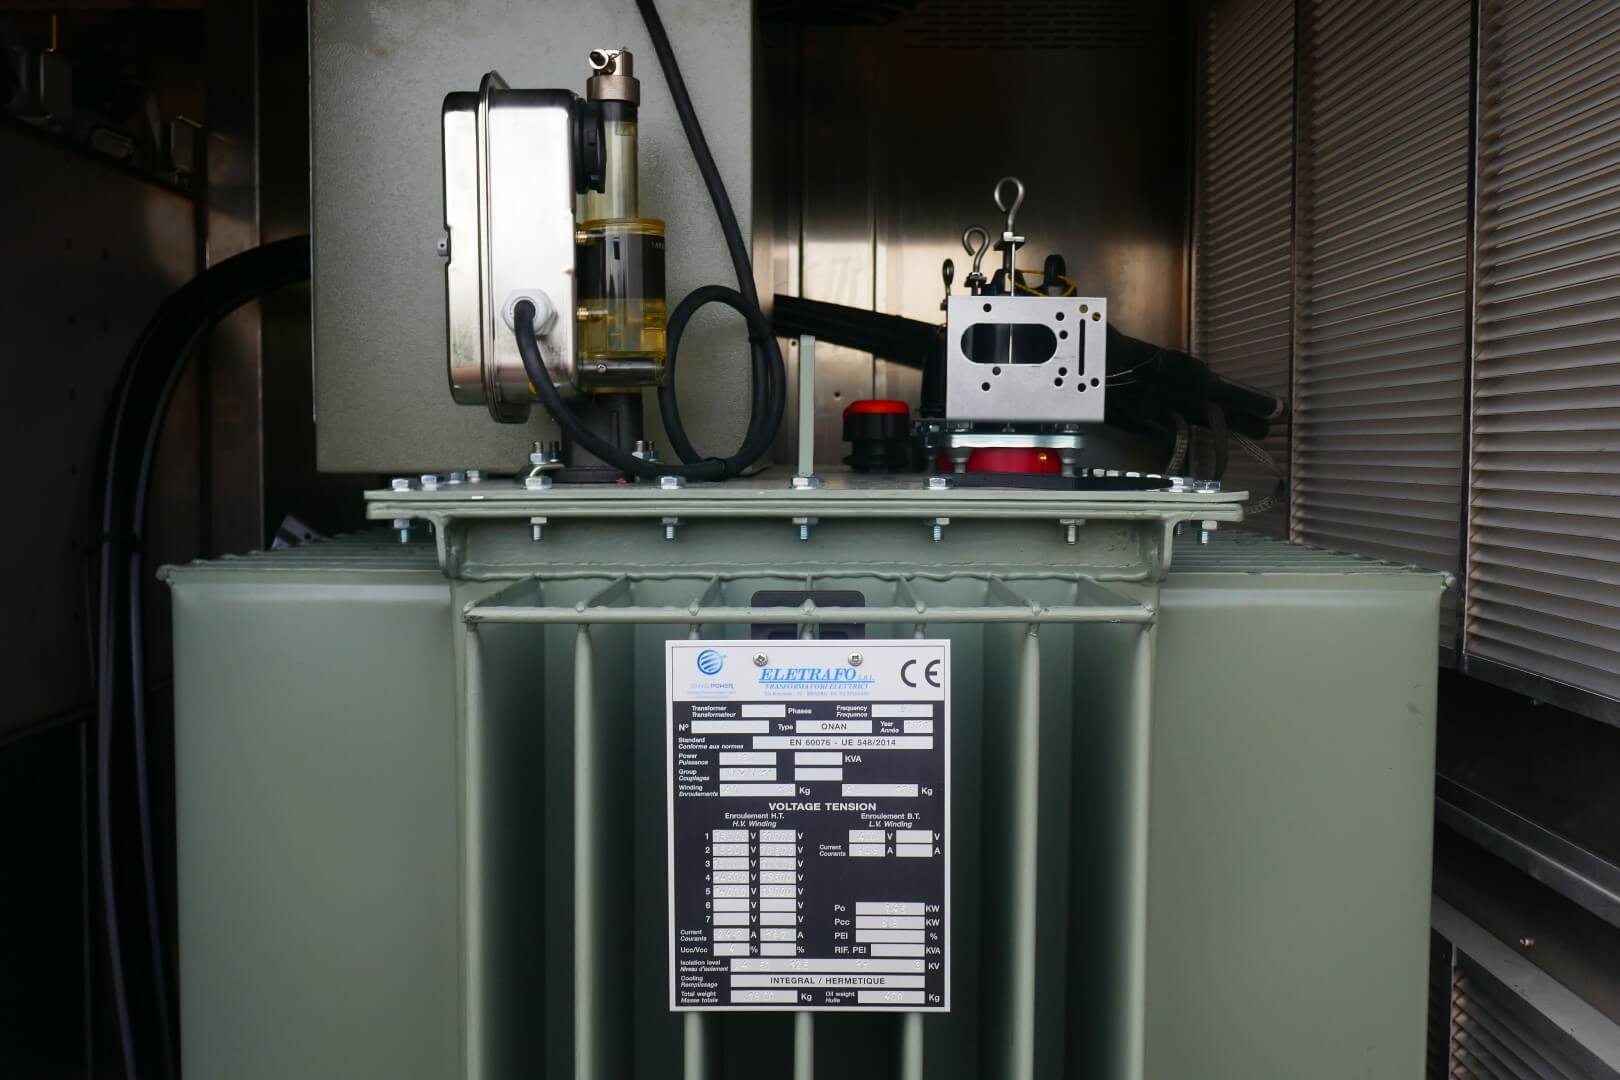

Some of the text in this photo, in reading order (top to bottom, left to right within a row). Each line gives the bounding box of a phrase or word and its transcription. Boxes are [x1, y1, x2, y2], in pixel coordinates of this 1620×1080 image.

[761, 668, 857, 681] ELETRAFO
[778, 723, 794, 731] Type
[845, 755, 862, 763] KVA
[799, 787, 811, 796] Kg
[921, 787, 933, 796] Kg
[768, 802, 877, 811] VOLTAGE TENSION
[732, 820, 777, 829] H.V. Winding
[884, 820, 913, 829] Winding
[934, 833, 940, 841] V
[934, 847, 941, 855] A
[834, 904, 846, 912] Po
[925, 905, 940, 913] KW
[834, 918, 850, 926] Pcc
[750, 931, 757, 939] A
[798, 931, 804, 939] A
[834, 932, 848, 940] PEI
[834, 946, 867, 954] RIF. PEI
[925, 947, 941, 955] KVA
[928, 962, 940, 970] KV
[825, 977, 885, 985] HERMETIQUE
[800, 992, 812, 1001] Kg
[928, 993, 940, 1002] Kg
